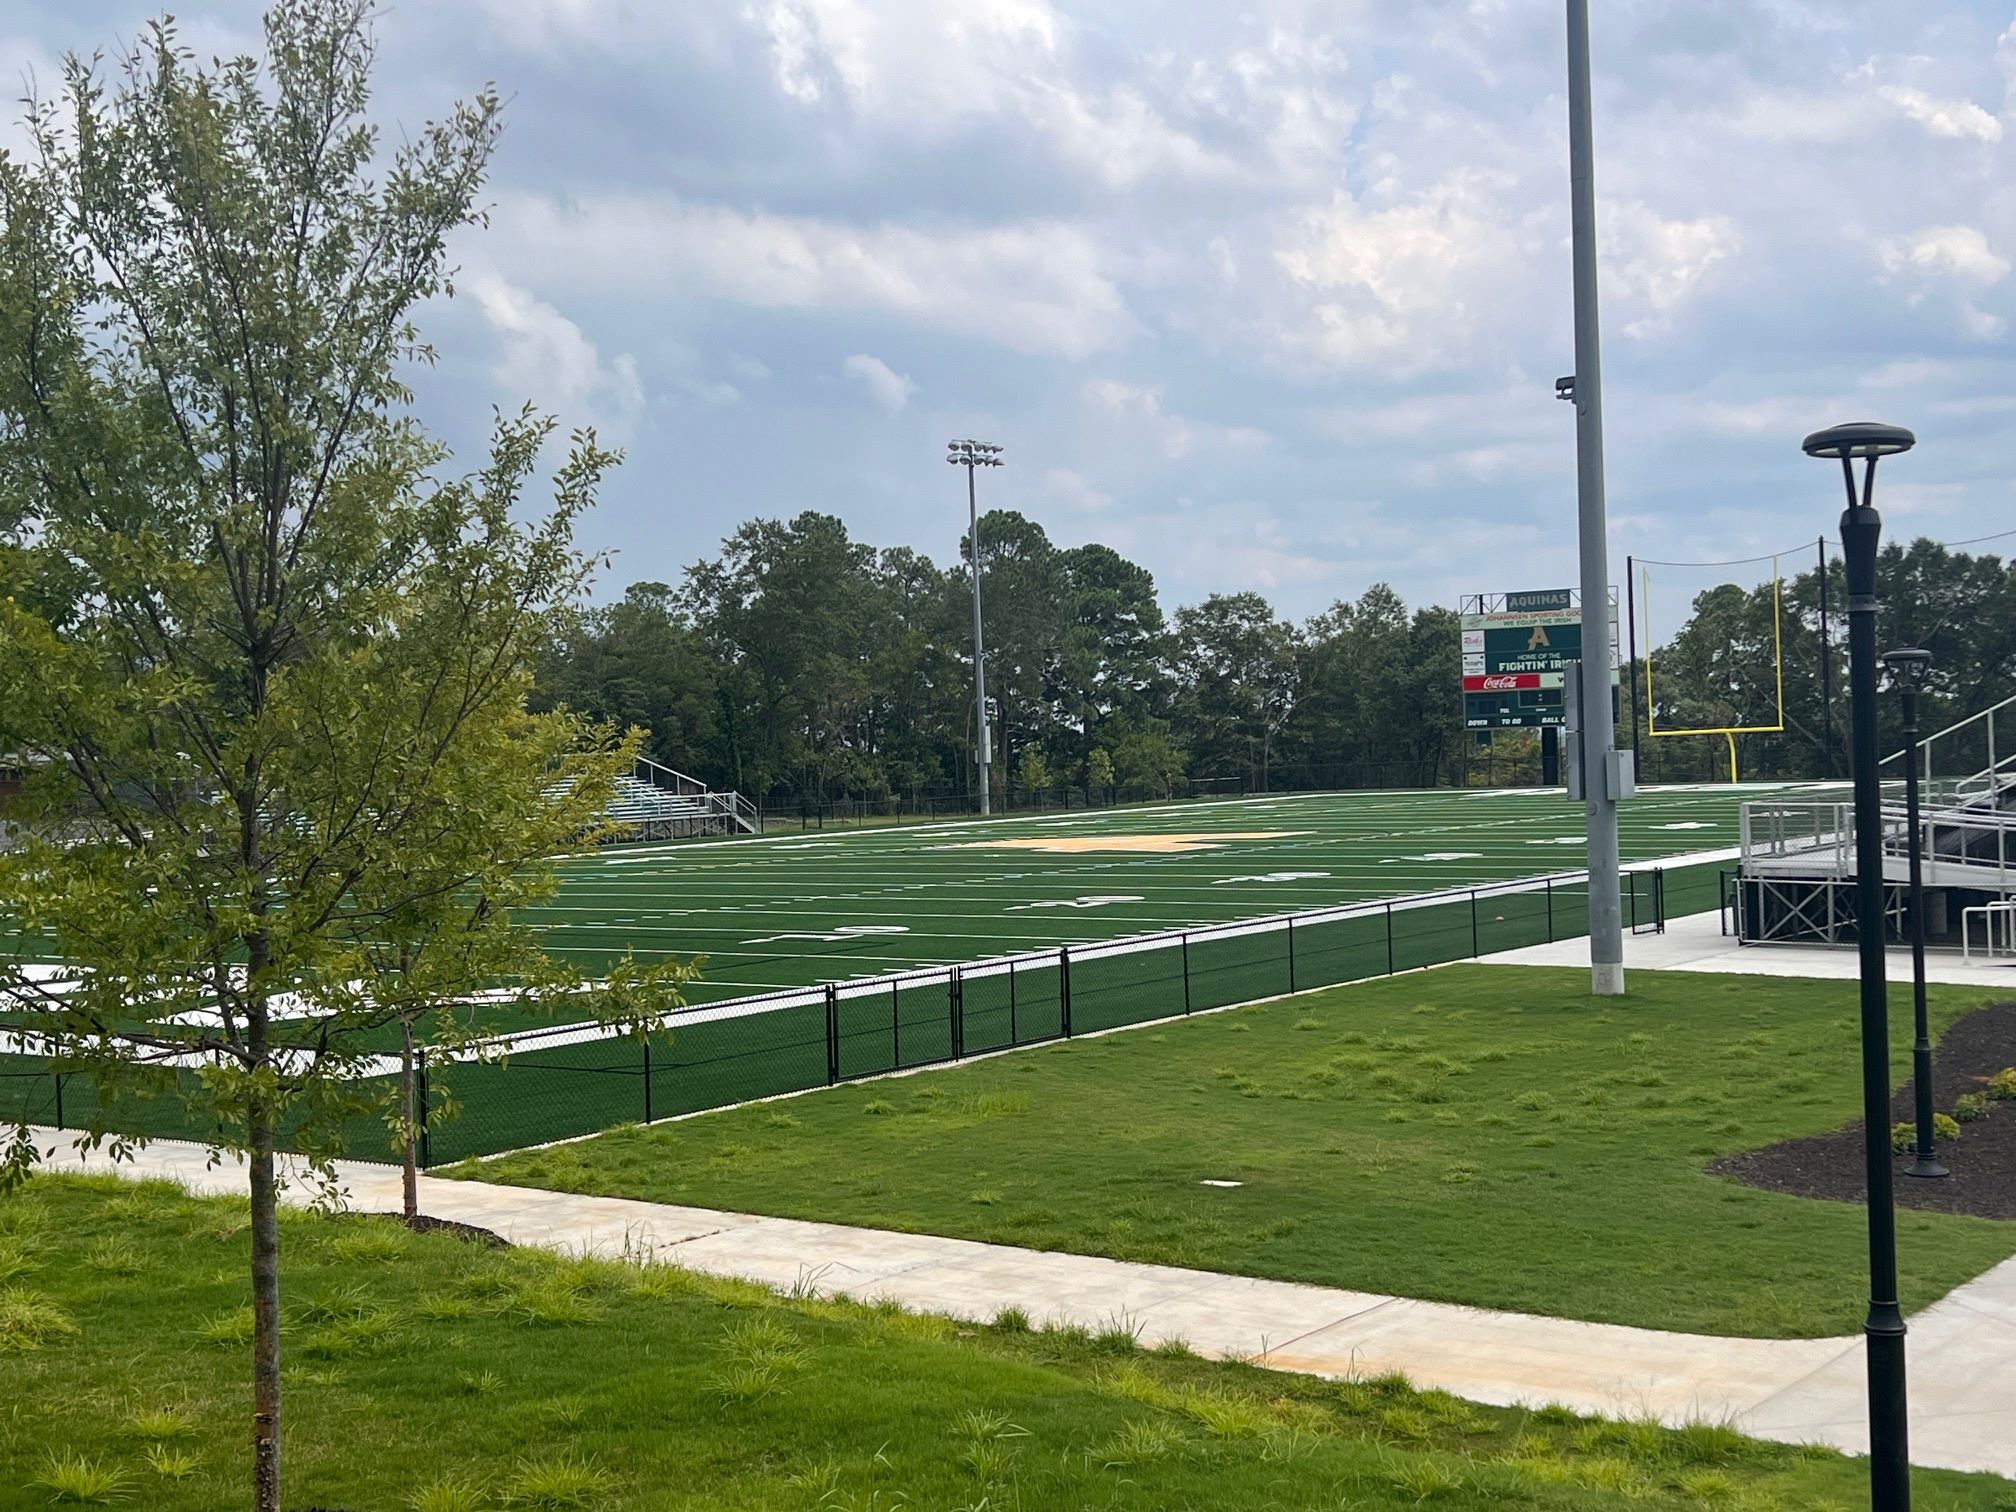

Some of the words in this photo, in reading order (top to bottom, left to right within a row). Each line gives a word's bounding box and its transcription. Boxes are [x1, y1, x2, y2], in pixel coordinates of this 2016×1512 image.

[1509, 593, 1568, 608] AQUINAS
[1530, 611, 1564, 619] SPORTING
[1527, 626, 1550, 651] A
[1499, 661, 1548, 672] FIGHTIN'
[1512, 717, 1522, 725] GO
[1541, 716, 1559, 724] BALL
